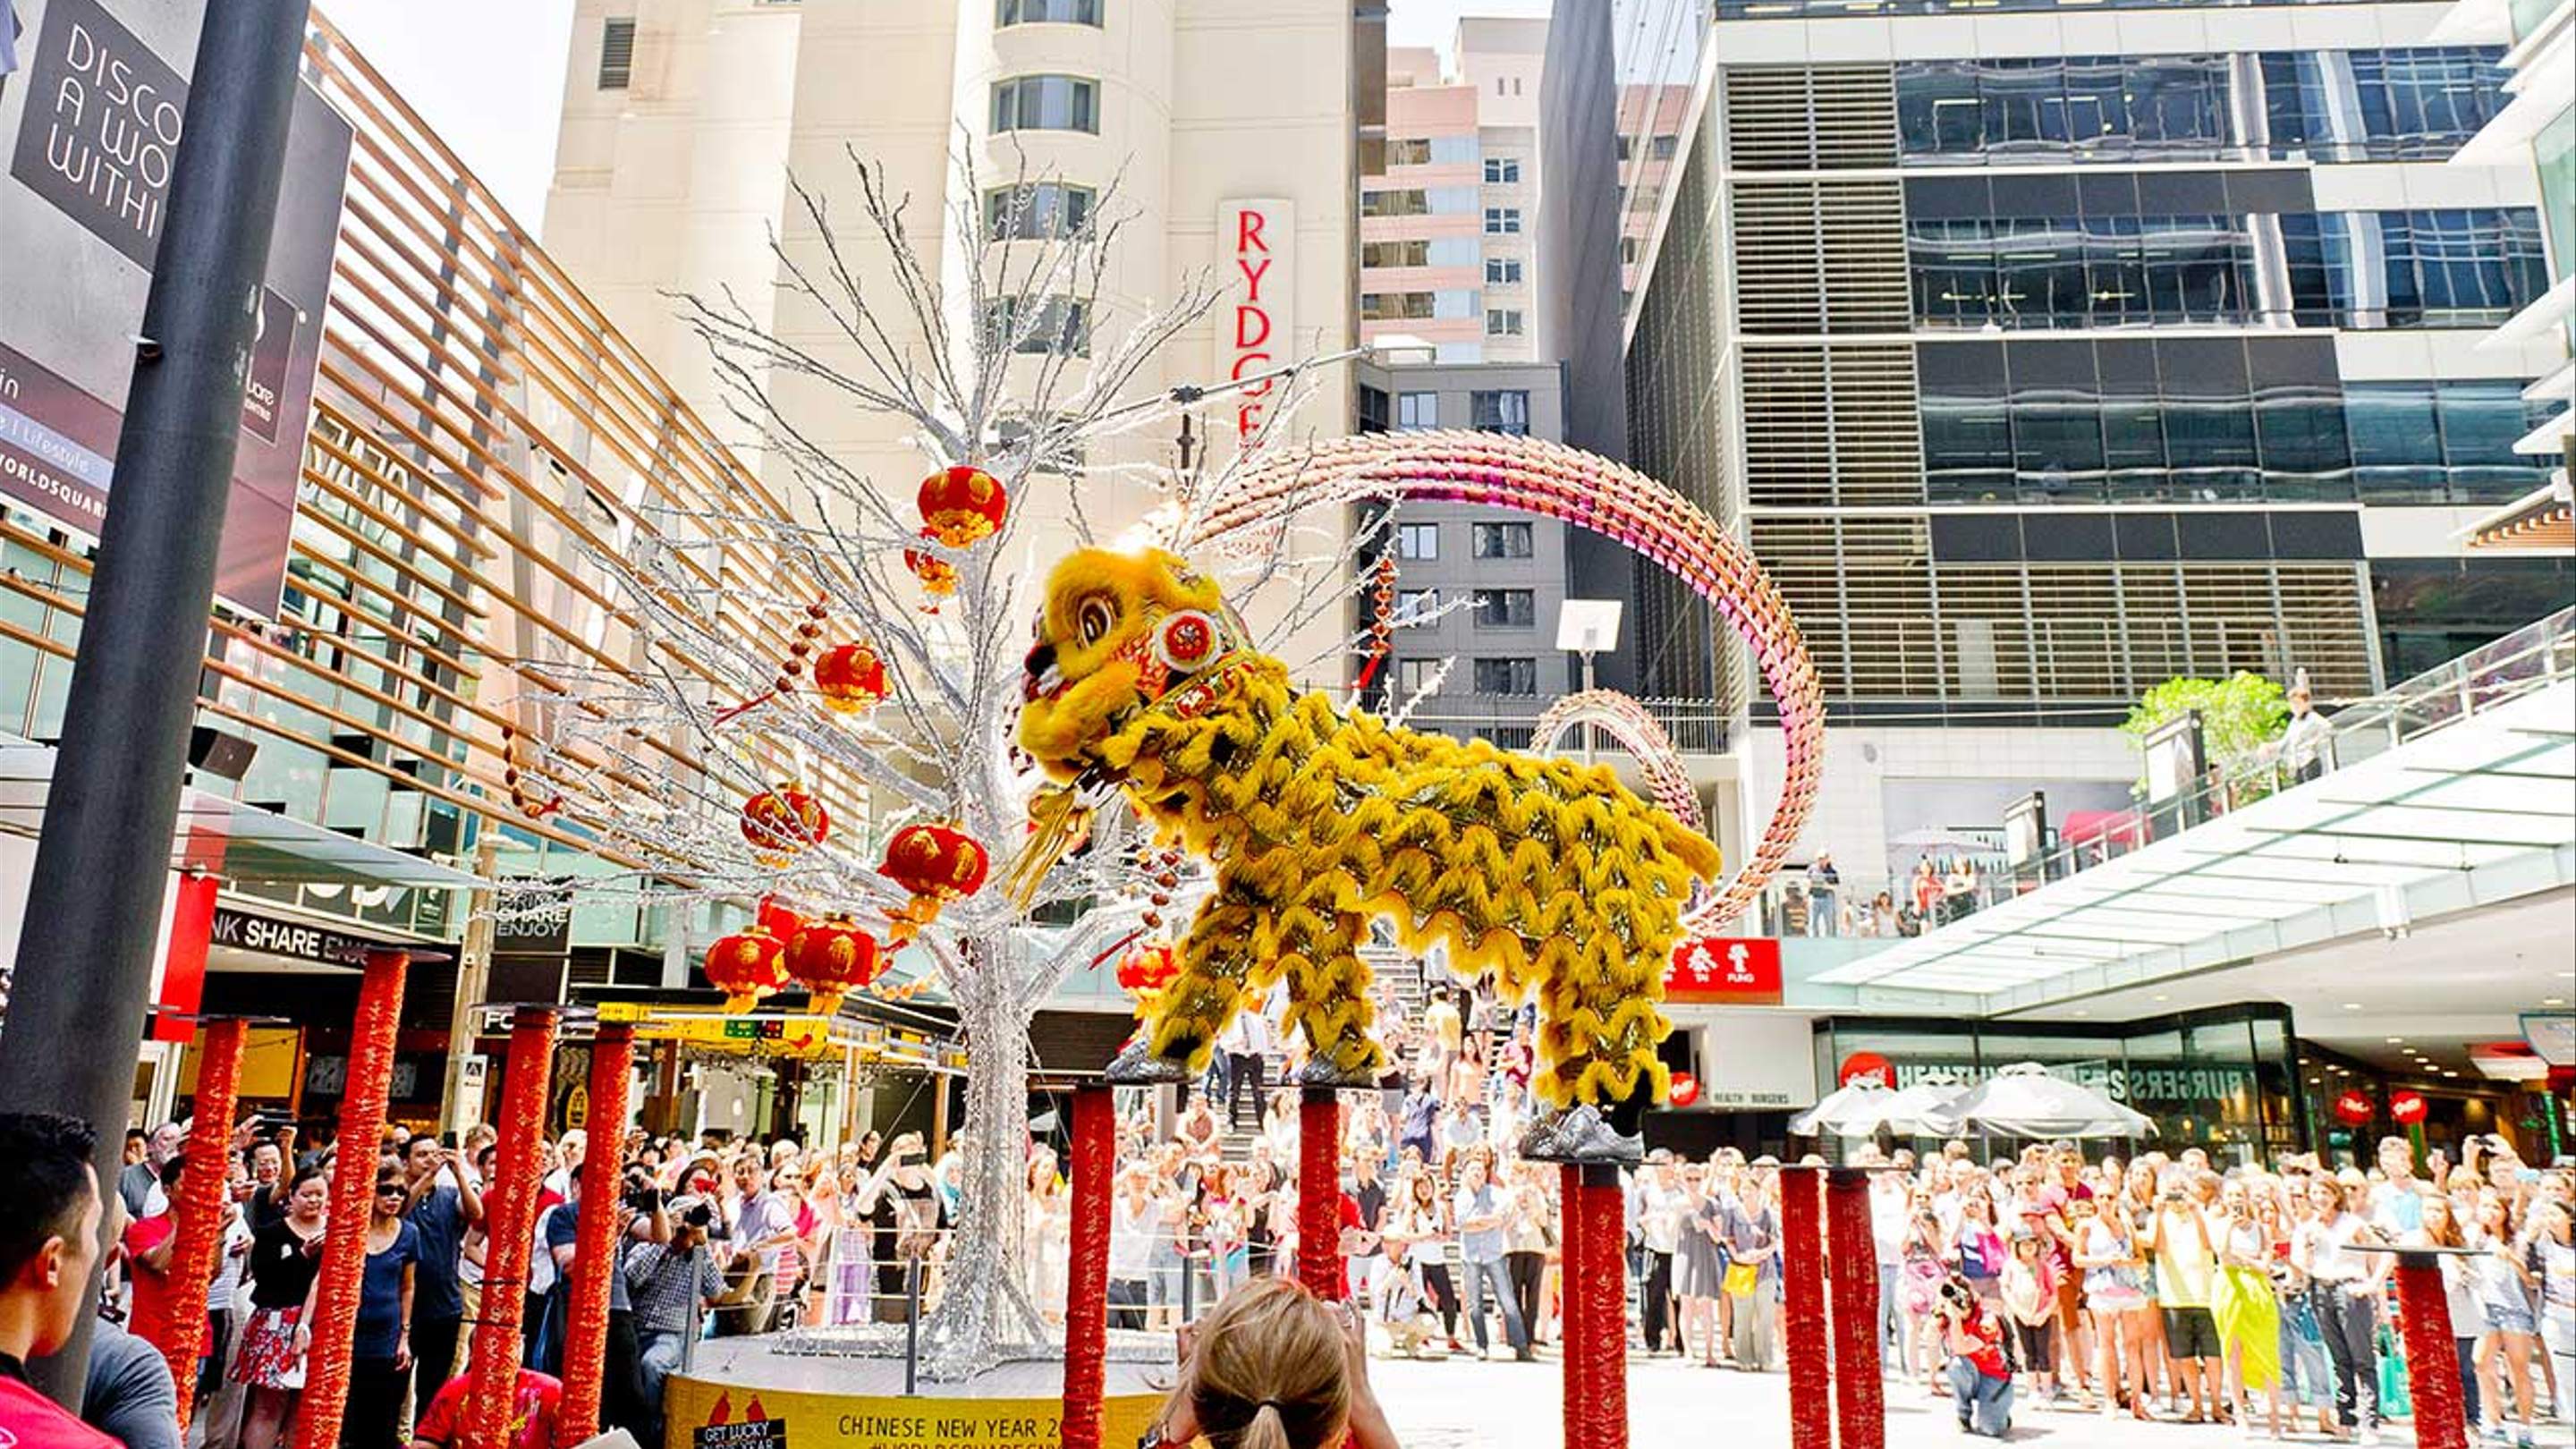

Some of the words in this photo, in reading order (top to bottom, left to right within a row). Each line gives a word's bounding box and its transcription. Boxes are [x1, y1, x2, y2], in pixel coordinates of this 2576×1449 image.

[56, 75, 82, 128] A
[99, 104, 170, 190] WO
[1231, 209, 1274, 454] RYDGE
[243, 918, 321, 957] SHARE
[496, 922, 563, 937] ENJOY
[705, 1425, 728, 1444] GET
[729, 1420, 770, 1440] LUCKY
[837, 1415, 927, 1438] CHINESE
[936, 1418, 978, 1438] NEW
[985, 1418, 1038, 1438] YEAR
